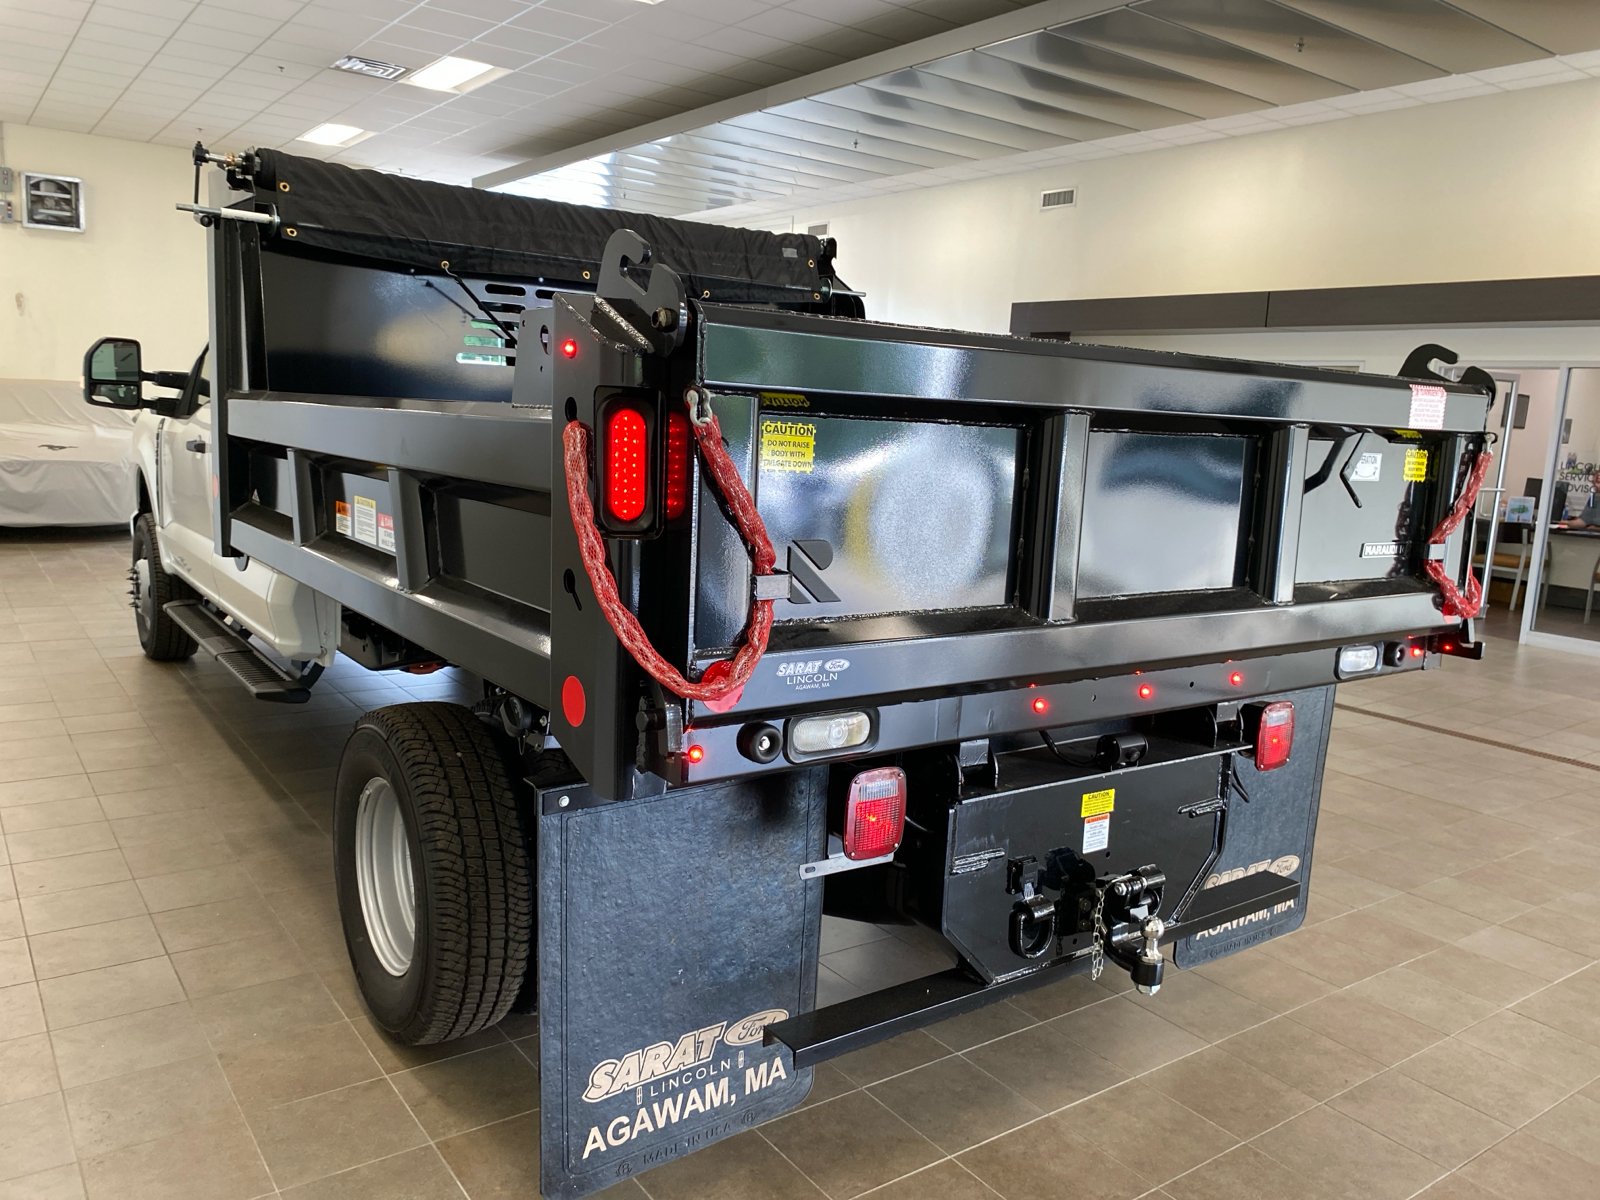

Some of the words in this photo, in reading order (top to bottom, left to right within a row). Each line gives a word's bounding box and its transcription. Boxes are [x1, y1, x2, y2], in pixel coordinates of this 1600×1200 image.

[765, 424, 813, 436] CAUTION
[1560, 461, 1600, 471] LINCOL
[776, 660, 823, 676] SARAT
[787, 673, 838, 684] LINCOLN
[581, 1020, 728, 1103] SARAT
[650, 1058, 731, 1097] LINCOLN
[581, 1077, 736, 1160] AGAWAM,
[745, 1056, 787, 1095] MA
[643, 1142, 679, 1165] MADE
[687, 1133, 701, 1147] IN
[705, 1121, 731, 1141] USA
